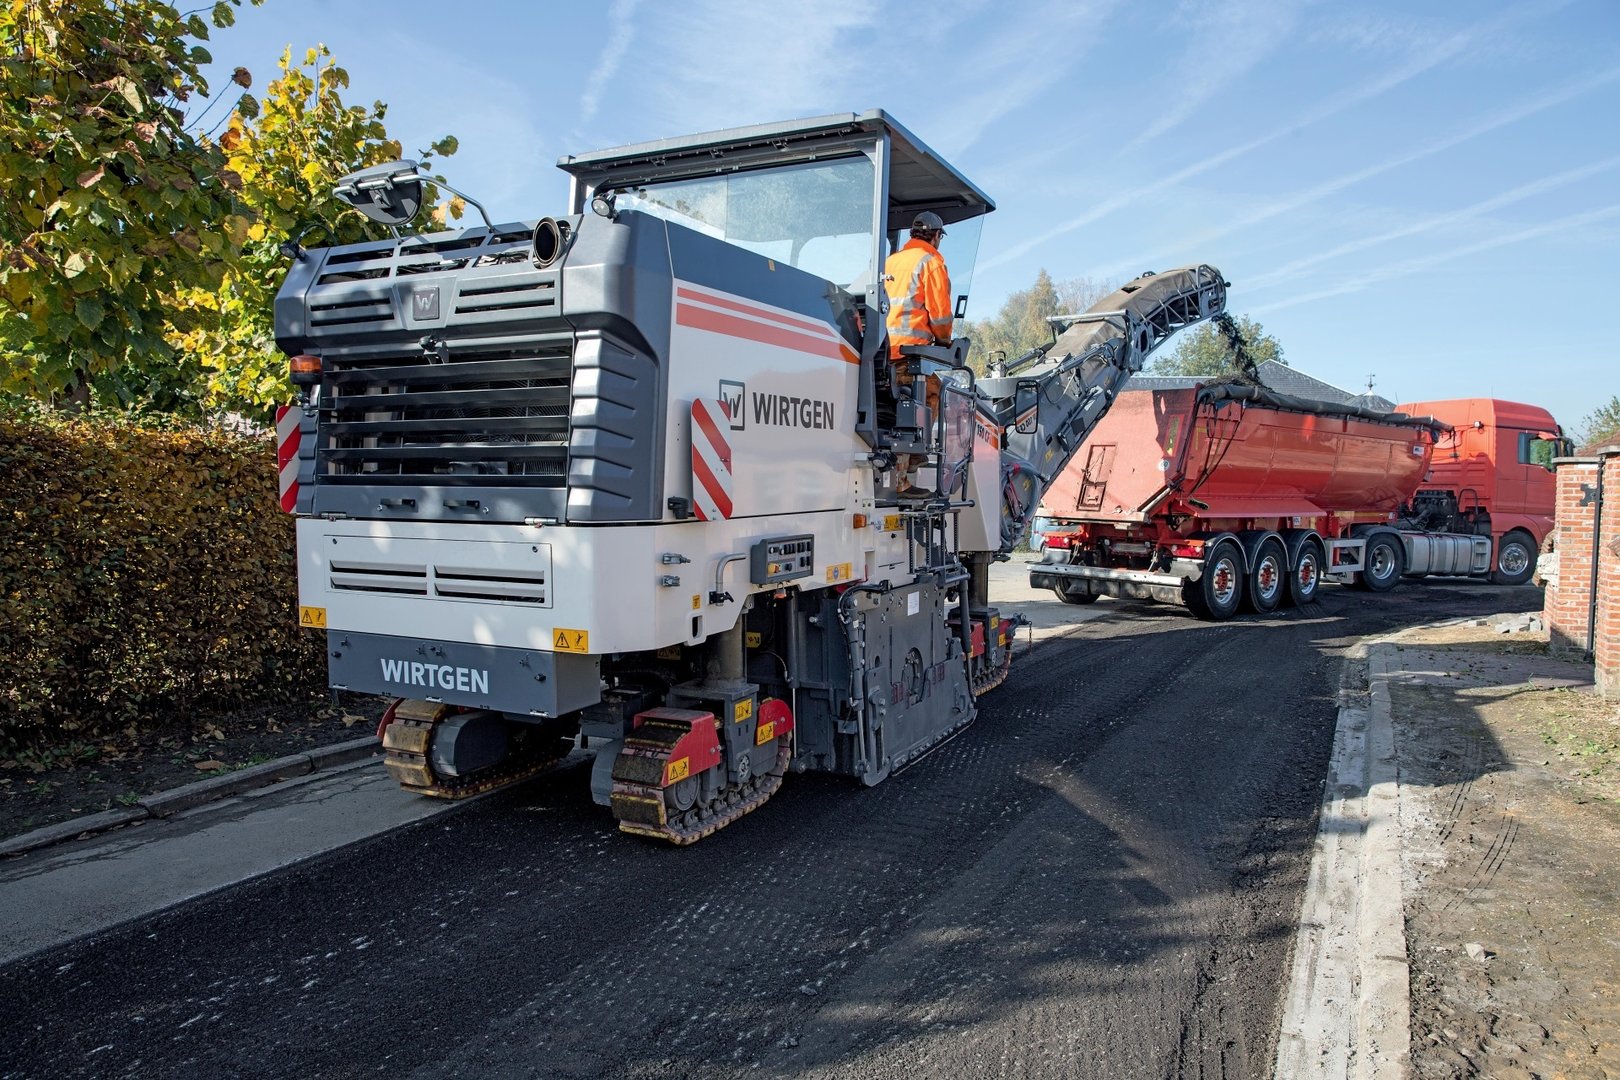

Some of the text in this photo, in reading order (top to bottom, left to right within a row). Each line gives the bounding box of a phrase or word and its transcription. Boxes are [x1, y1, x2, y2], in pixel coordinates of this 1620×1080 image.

[415, 293, 434, 310] W
[752, 391, 834, 430] WIRTGEN
[380, 658, 489, 695] WIRTGEN
